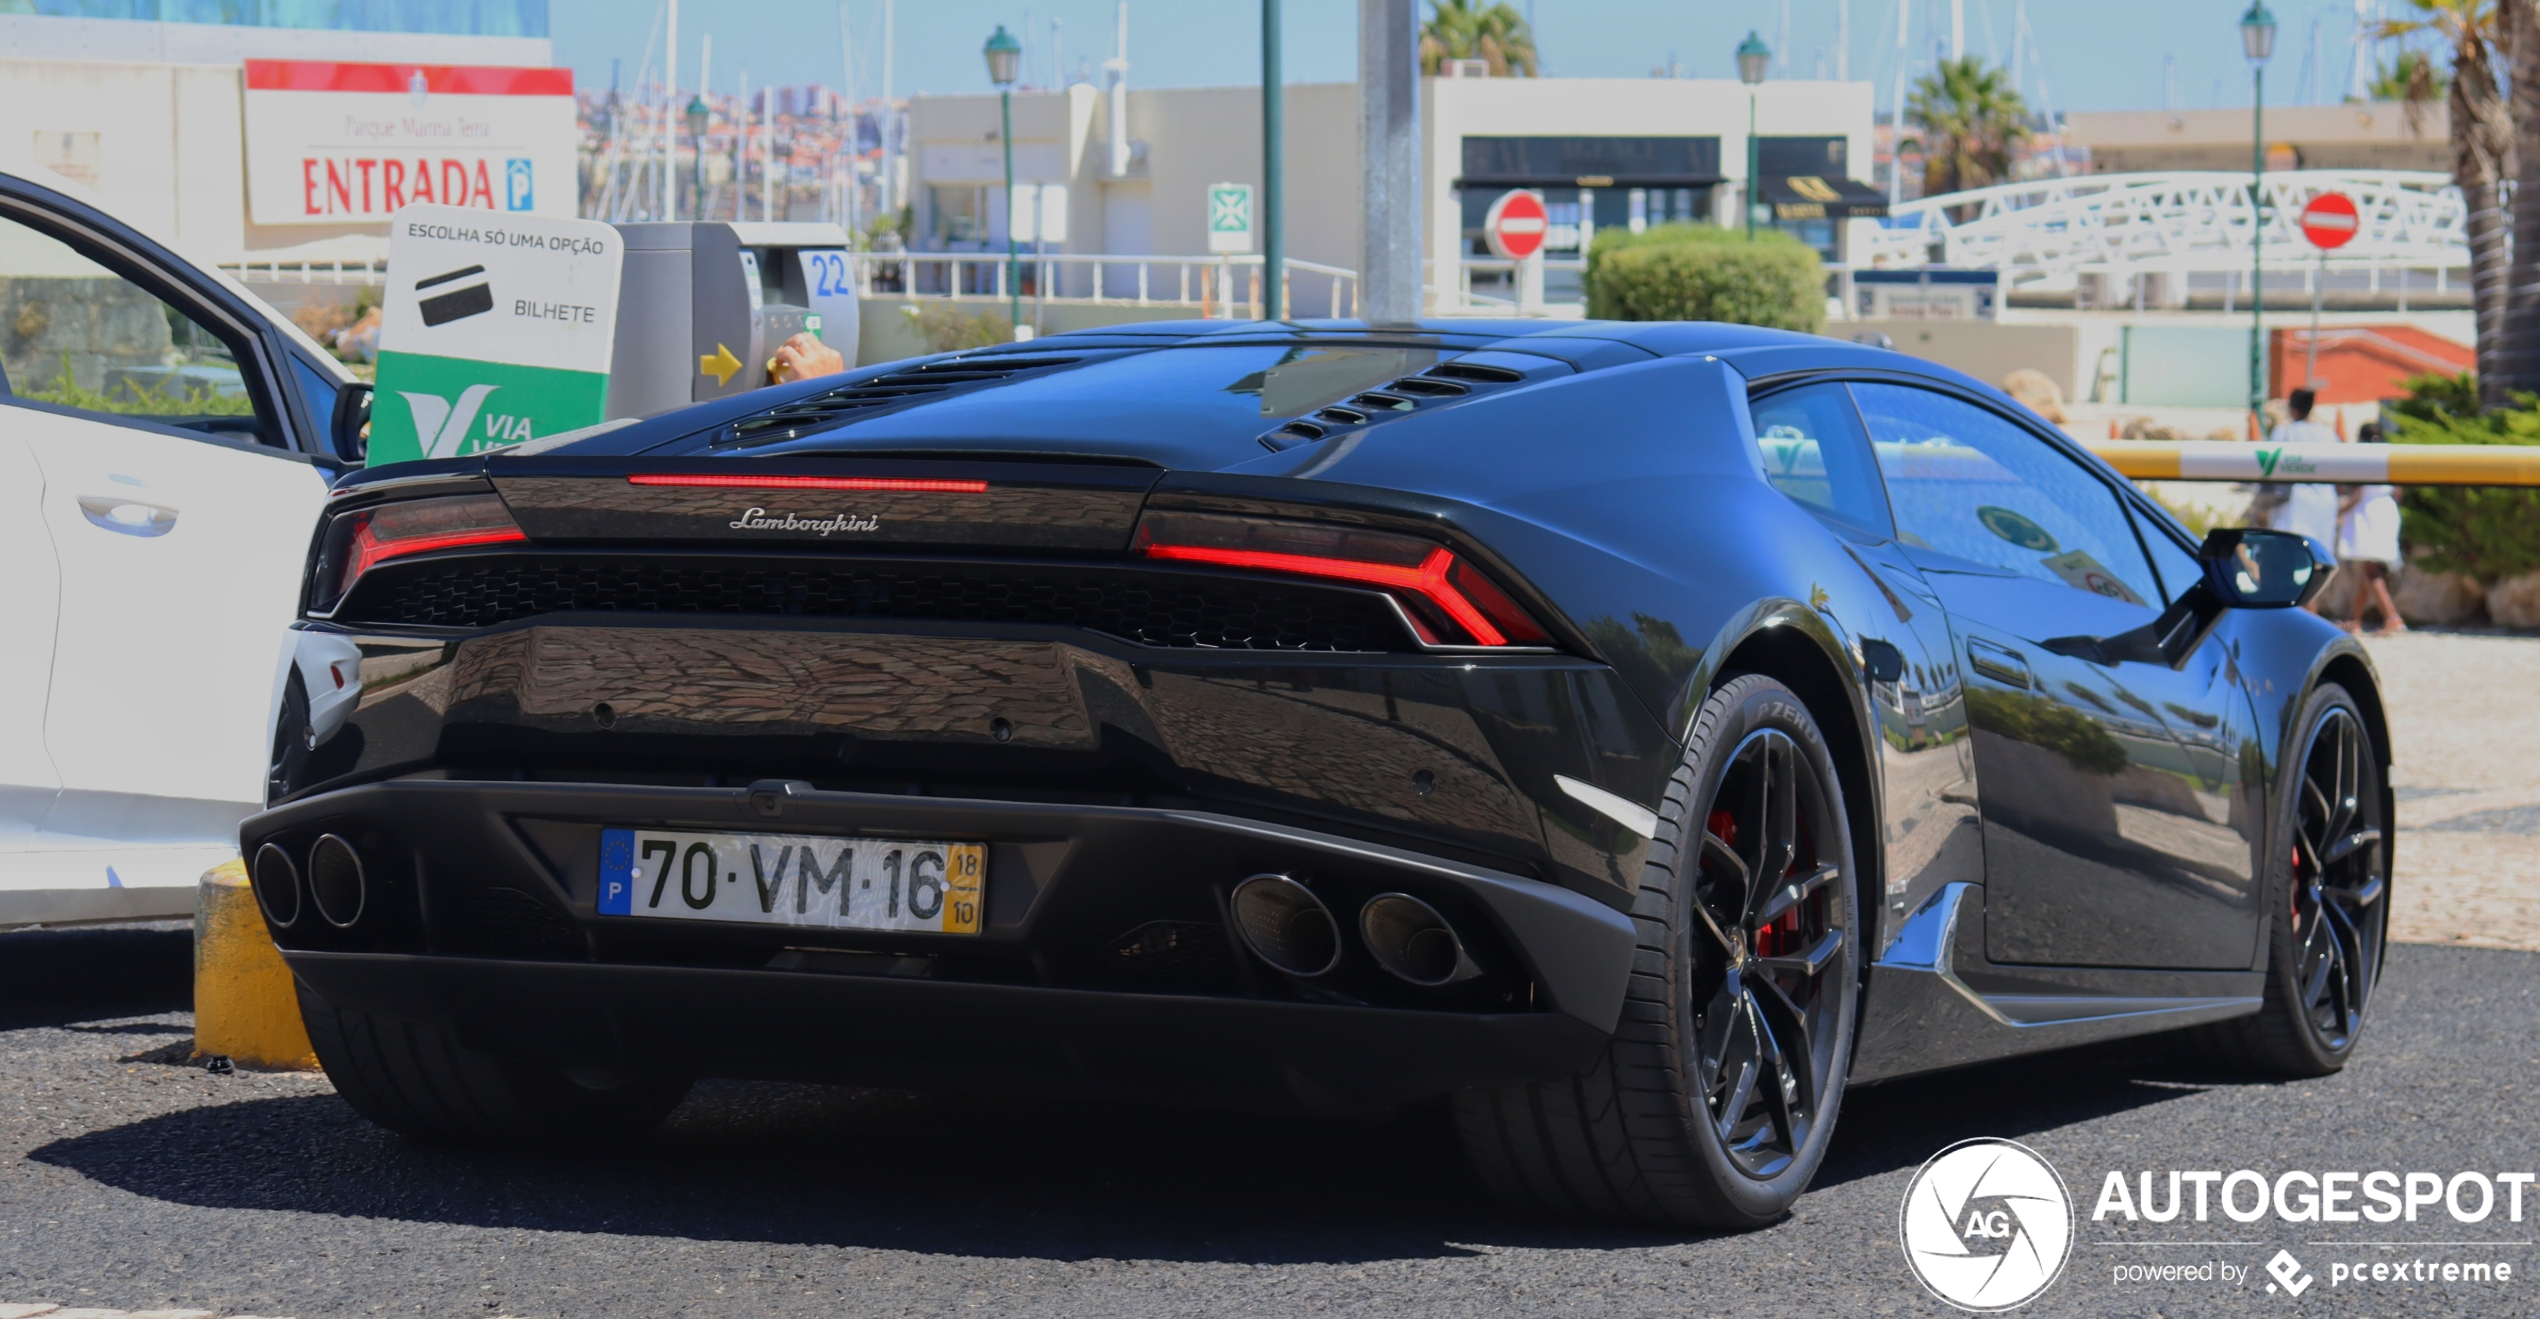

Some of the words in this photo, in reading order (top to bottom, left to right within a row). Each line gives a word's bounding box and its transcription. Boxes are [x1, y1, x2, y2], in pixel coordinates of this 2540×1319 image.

[302, 158, 496, 215] ENTRADA
[408, 223, 480, 243] ESCOLHA
[484, 228, 506, 245] SÓ
[509, 233, 545, 249] UMA
[549, 236, 604, 256] OPÇÃO
[811, 254, 849, 297] 22
[514, 299, 596, 323] BILHETE
[486, 413, 533, 441] VIA
[729, 507, 879, 537] Lamborghini
[956, 854, 978, 876] 18
[608, 882, 623, 900] P
[953, 901, 974, 924] 10
